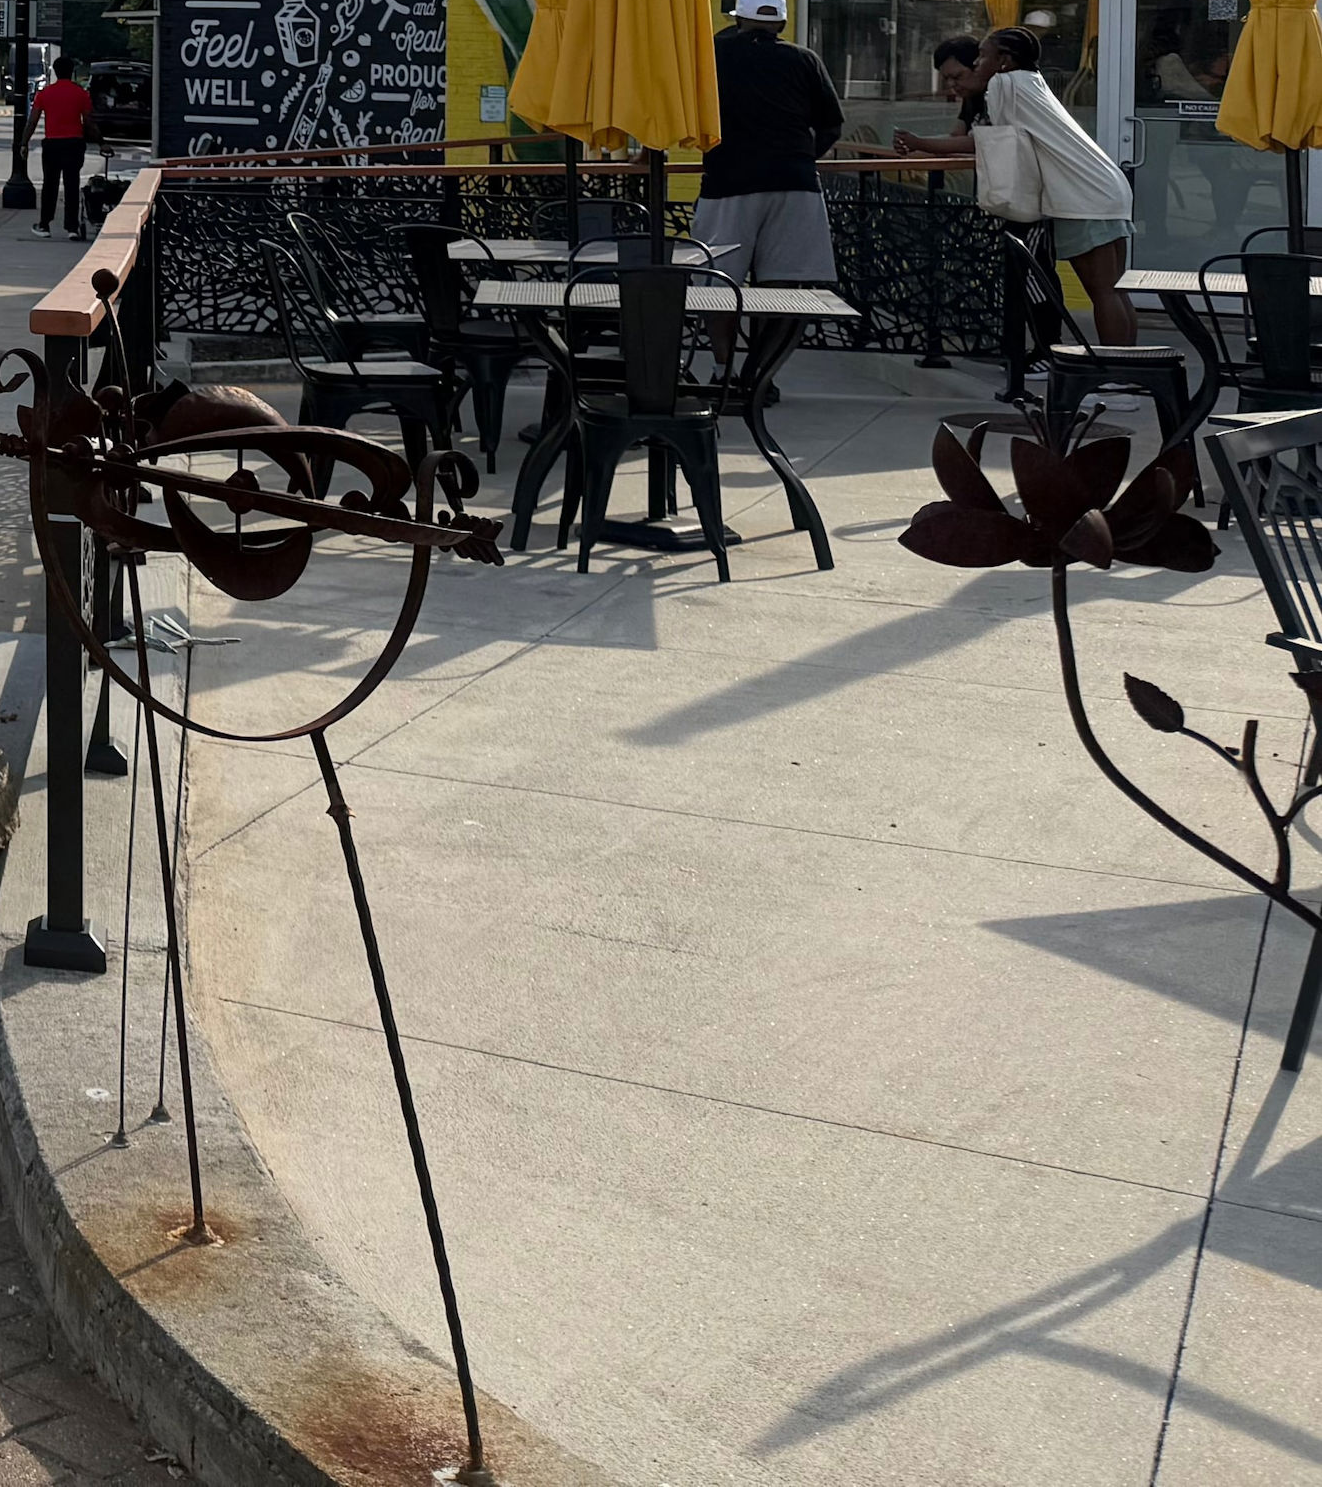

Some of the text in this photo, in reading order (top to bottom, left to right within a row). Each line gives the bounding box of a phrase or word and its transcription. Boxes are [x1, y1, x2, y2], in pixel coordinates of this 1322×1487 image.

[181, 19, 258, 68] Feel
[395, 20, 446, 61] Real
[185, 78, 255, 106] WELL
[410, 89, 436, 116] for
